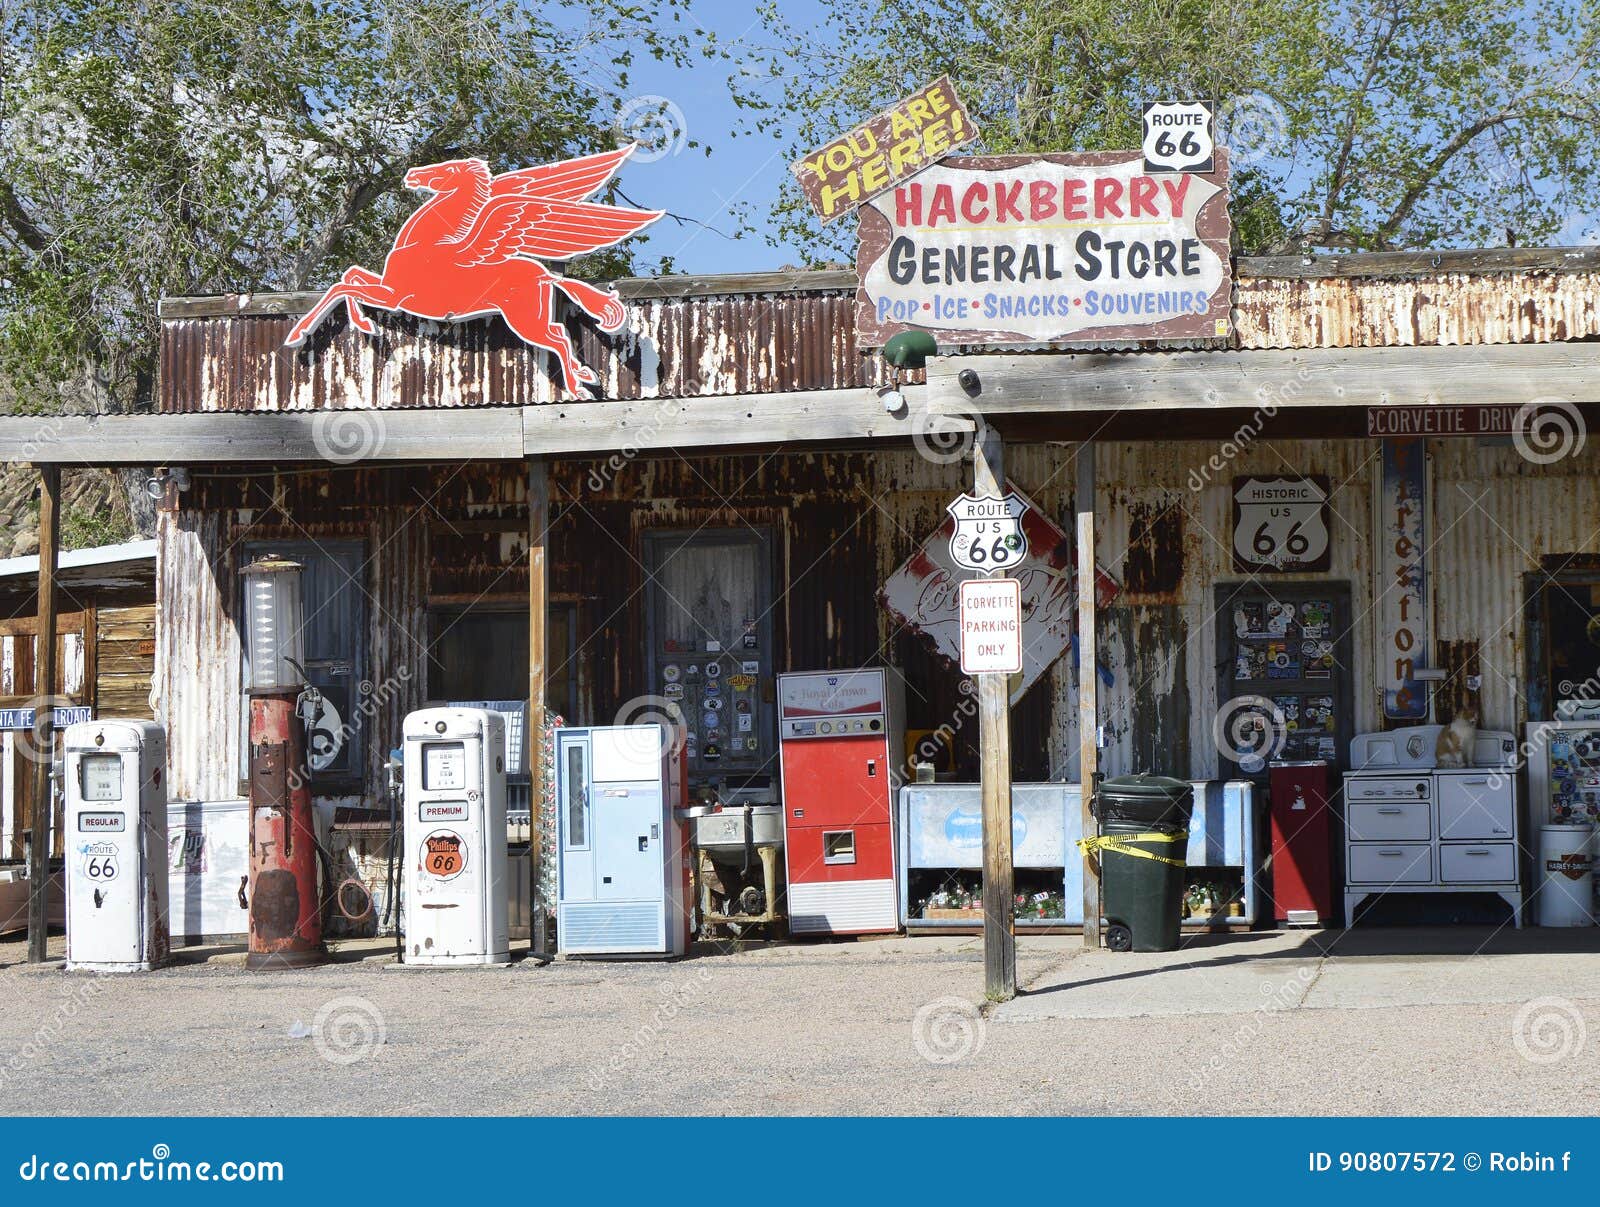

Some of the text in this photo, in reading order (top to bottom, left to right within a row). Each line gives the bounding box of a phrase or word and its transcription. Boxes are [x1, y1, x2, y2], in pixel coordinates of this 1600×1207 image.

[1152, 113, 1202, 126] ROUTE
[804, 87, 950, 181] YOU ARE
[1154, 131, 1201, 157] 66
[820, 109, 965, 215] HERE!
[895, 174, 1191, 228] HACKBERRY
[887, 230, 1201, 285] GENERAL STORE
[1376, 407, 1531, 433] CORVETTE DRIVE
[1252, 488, 1309, 498] HISTORIC
[967, 504, 1011, 516] ROUTE
[1253, 521, 1309, 555] 66
[969, 536, 1009, 563] 66
[967, 597, 1014, 609] CORVETTE
[966, 620, 1016, 632] PARKING
[977, 644, 1006, 656] ONLY
[21, 711, 33, 726] FE
[426, 807, 462, 816] PREMIUM
[85, 818, 119, 826] REGULAR
[88, 857, 115, 877] 66
[433, 855, 455, 871] 66
